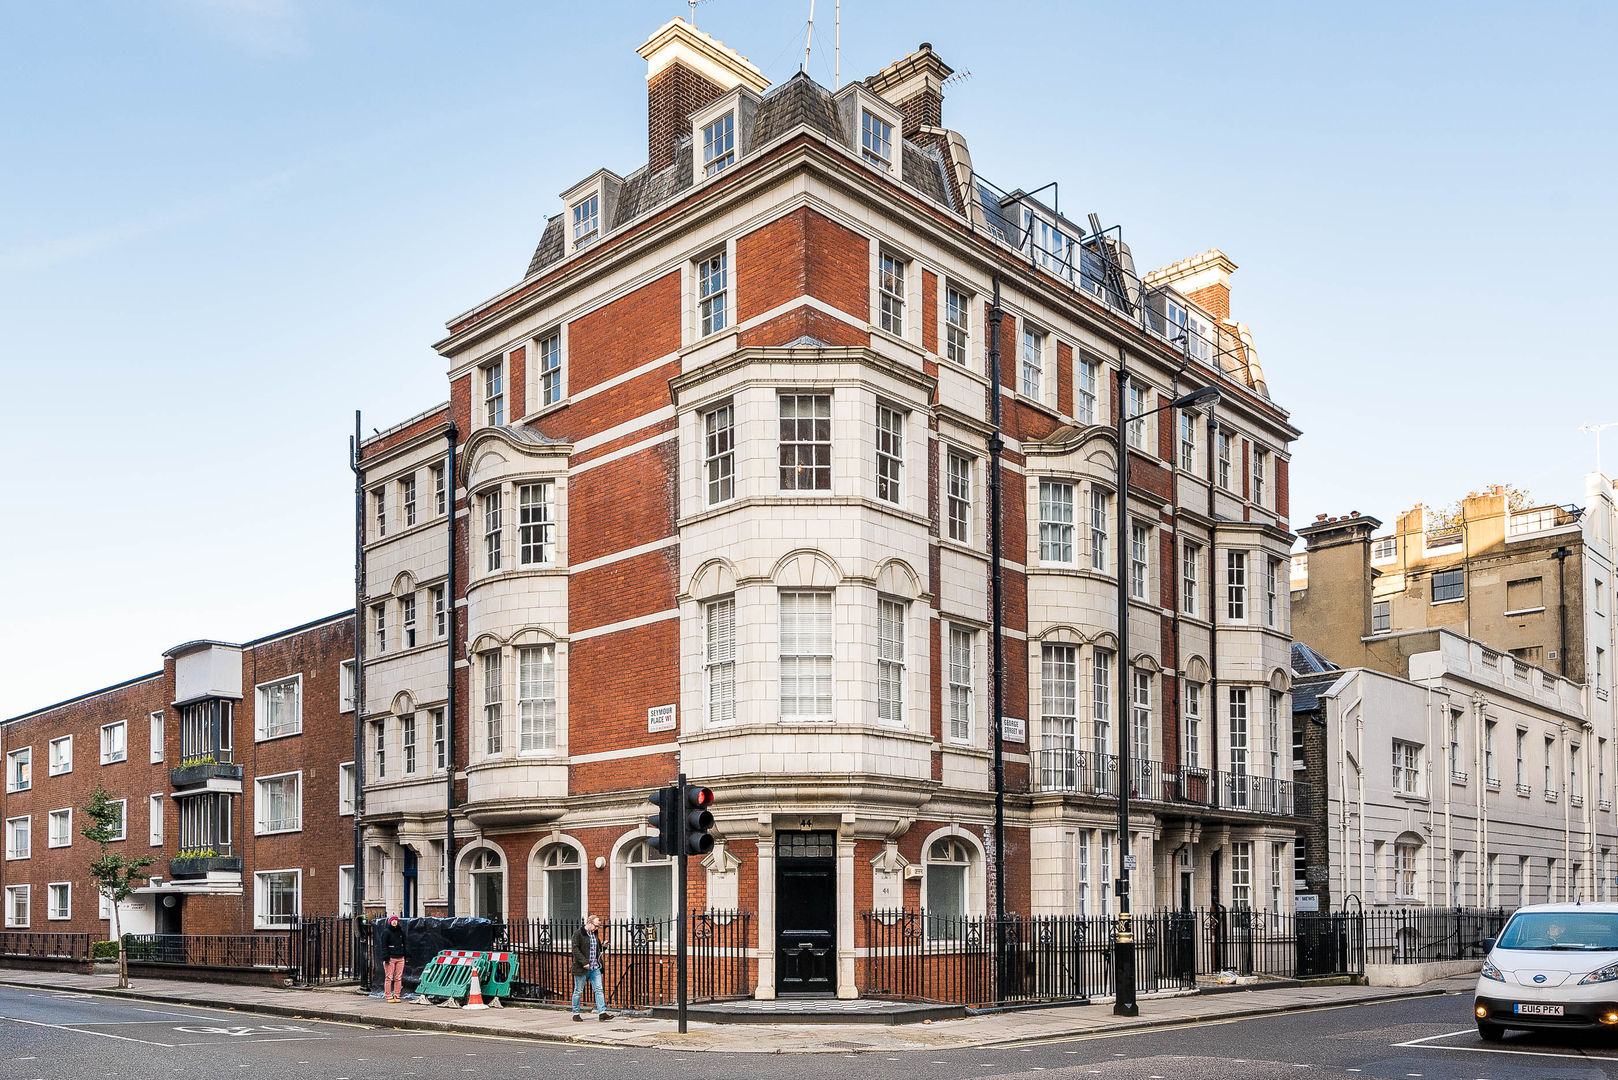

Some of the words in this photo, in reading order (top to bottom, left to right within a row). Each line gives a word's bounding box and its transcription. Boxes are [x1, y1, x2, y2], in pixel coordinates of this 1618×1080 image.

[650, 707, 672, 717] SEYMOUR
[650, 715, 664, 724] PLACE
[665, 714, 672, 722] W1
[1004, 719, 1019, 728] GEORGE
[1004, 726, 1018, 735] STREET
[800, 819, 812, 828] 44
[1521, 1005, 1541, 1013] EU15
[1542, 1005, 1561, 1015] PFK
